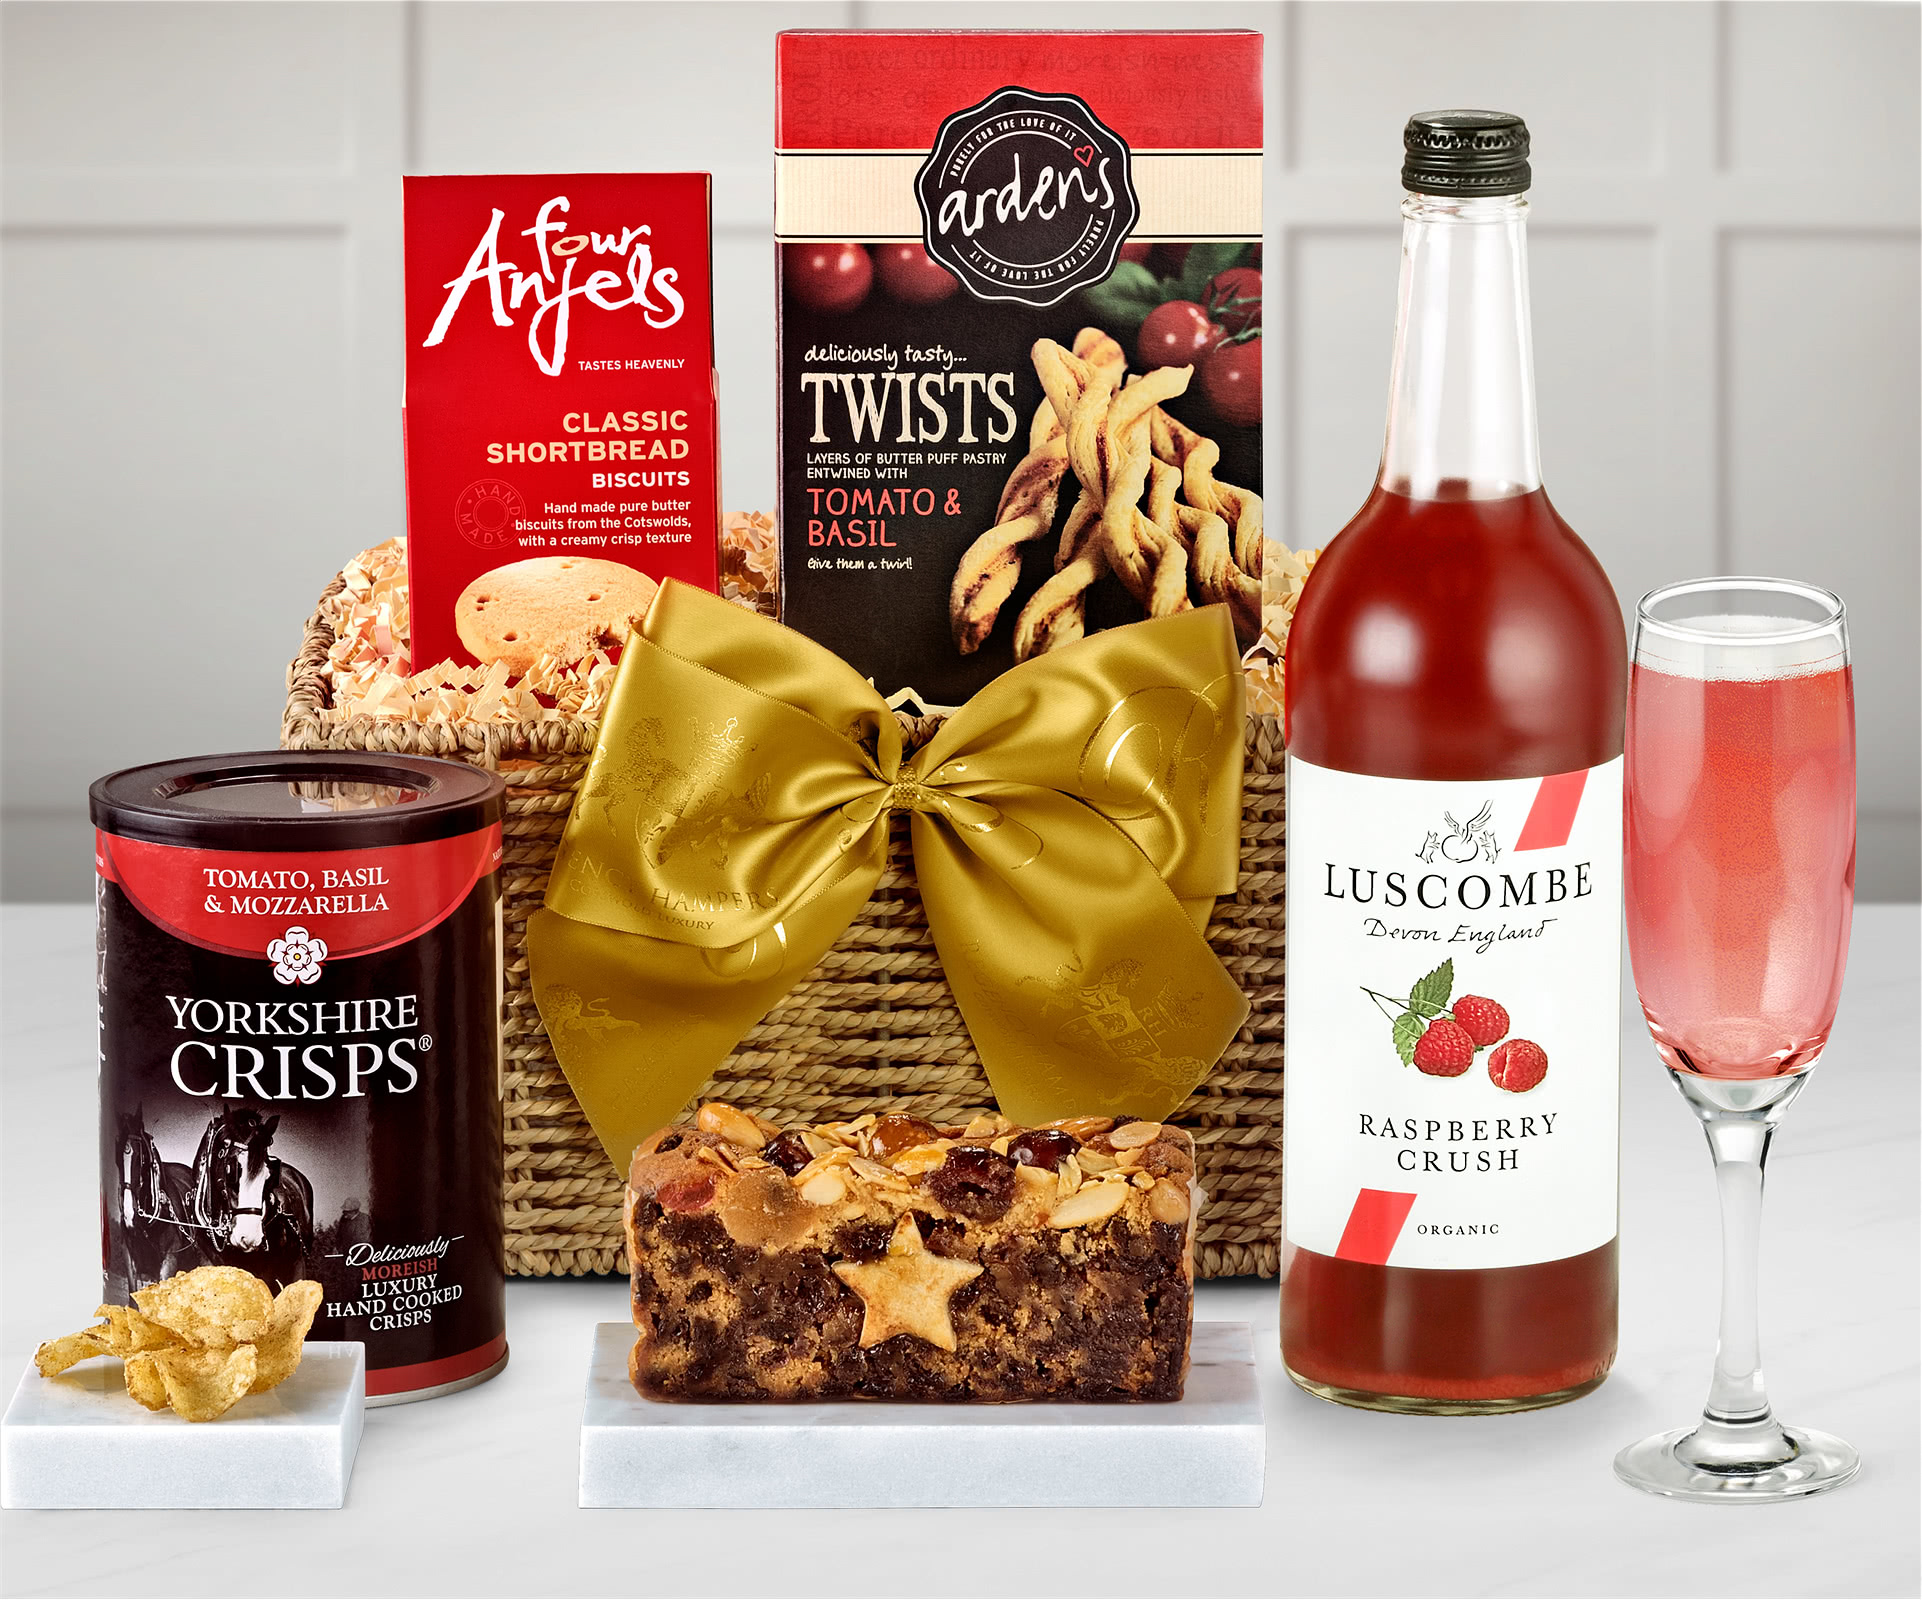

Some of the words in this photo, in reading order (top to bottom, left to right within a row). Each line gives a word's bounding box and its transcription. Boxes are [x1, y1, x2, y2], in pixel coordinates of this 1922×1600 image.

[950, 142, 975, 177] PURELY
[975, 127, 994, 144] FOR
[996, 118, 1016, 132] THE
[1020, 117, 1046, 129] LOVE
[1049, 121, 1063, 133] OF
[1065, 129, 1077, 141] IT
[520, 195, 652, 283] four
[1078, 219, 1105, 257] PURELY
[969, 250, 982, 263] IT
[983, 261, 998, 273] OF
[1057, 255, 1077, 273] FOR
[1001, 268, 1028, 281] LOVE
[1034, 268, 1054, 281] THE
[422, 207, 685, 377] Angels
[577, 360, 622, 372] TASTES
[625, 358, 686, 371] HEAVENLY
[804, 343, 898, 370] deliciously
[800, 371, 1018, 444] TWISTS
[562, 410, 689, 433] CLASSIC
[486, 439, 690, 464] SHORTBREAD
[806, 452, 851, 465] LAYERS
[855, 452, 873, 465] OF
[876, 452, 923, 465] BUTTER
[927, 452, 959, 465] PUFF
[963, 452, 1007, 465] PASTRY
[592, 471, 690, 489] BISCUITS
[806, 467, 871, 479] ENTWINED
[875, 467, 908, 479] WITH
[474, 484, 521, 516] HAND
[544, 502, 578, 514] Hand
[580, 501, 616, 513] made
[619, 502, 649, 516] pure
[651, 500, 691, 512] butter
[806, 488, 936, 516] TOMATO
[943, 488, 962, 515] &
[460, 512, 508, 544] MADE
[515, 518, 565, 531] biscuits
[567, 517, 598, 530] from
[600, 517, 622, 529] the
[624, 515, 692, 530] Cotswolds,
[808, 519, 897, 548] BASIL
[518, 535, 546, 547] with
[549, 537, 557, 546] a
[560, 534, 608, 549] creamy
[611, 532, 642, 546] crisp
[646, 532, 692, 544] texture
[807, 557, 834, 570] Give
[836, 557, 865, 570] them
[867, 562, 878, 570] a
[880, 556, 913, 570] twirl!
[203, 869, 316, 890] TOMATO,
[322, 866, 390, 888] BASIL
[1324, 861, 1593, 910] LUSCOMBE
[203, 894, 226, 914] &
[230, 893, 390, 916] MOZZARELLA
[651, 886, 780, 913] HAMPERS
[1363, 918, 1442, 942] Devon
[1447, 918, 1559, 954] England
[165, 994, 419, 1036] YORKSHIRE
[1359, 1112, 1558, 1142] RASPBERRY
[1397, 1148, 1519, 1173] CRUSH
[1417, 1223, 1499, 1236] ORGANIC
[345, 1235, 450, 1267] Deliciously
[361, 1257, 438, 1281] MOREISH
[361, 1273, 438, 1298] LUXURY
[326, 1299, 386, 1318] HAND
[392, 1284, 463, 1311] COOKED
[369, 1308, 432, 1331] CRISPS
